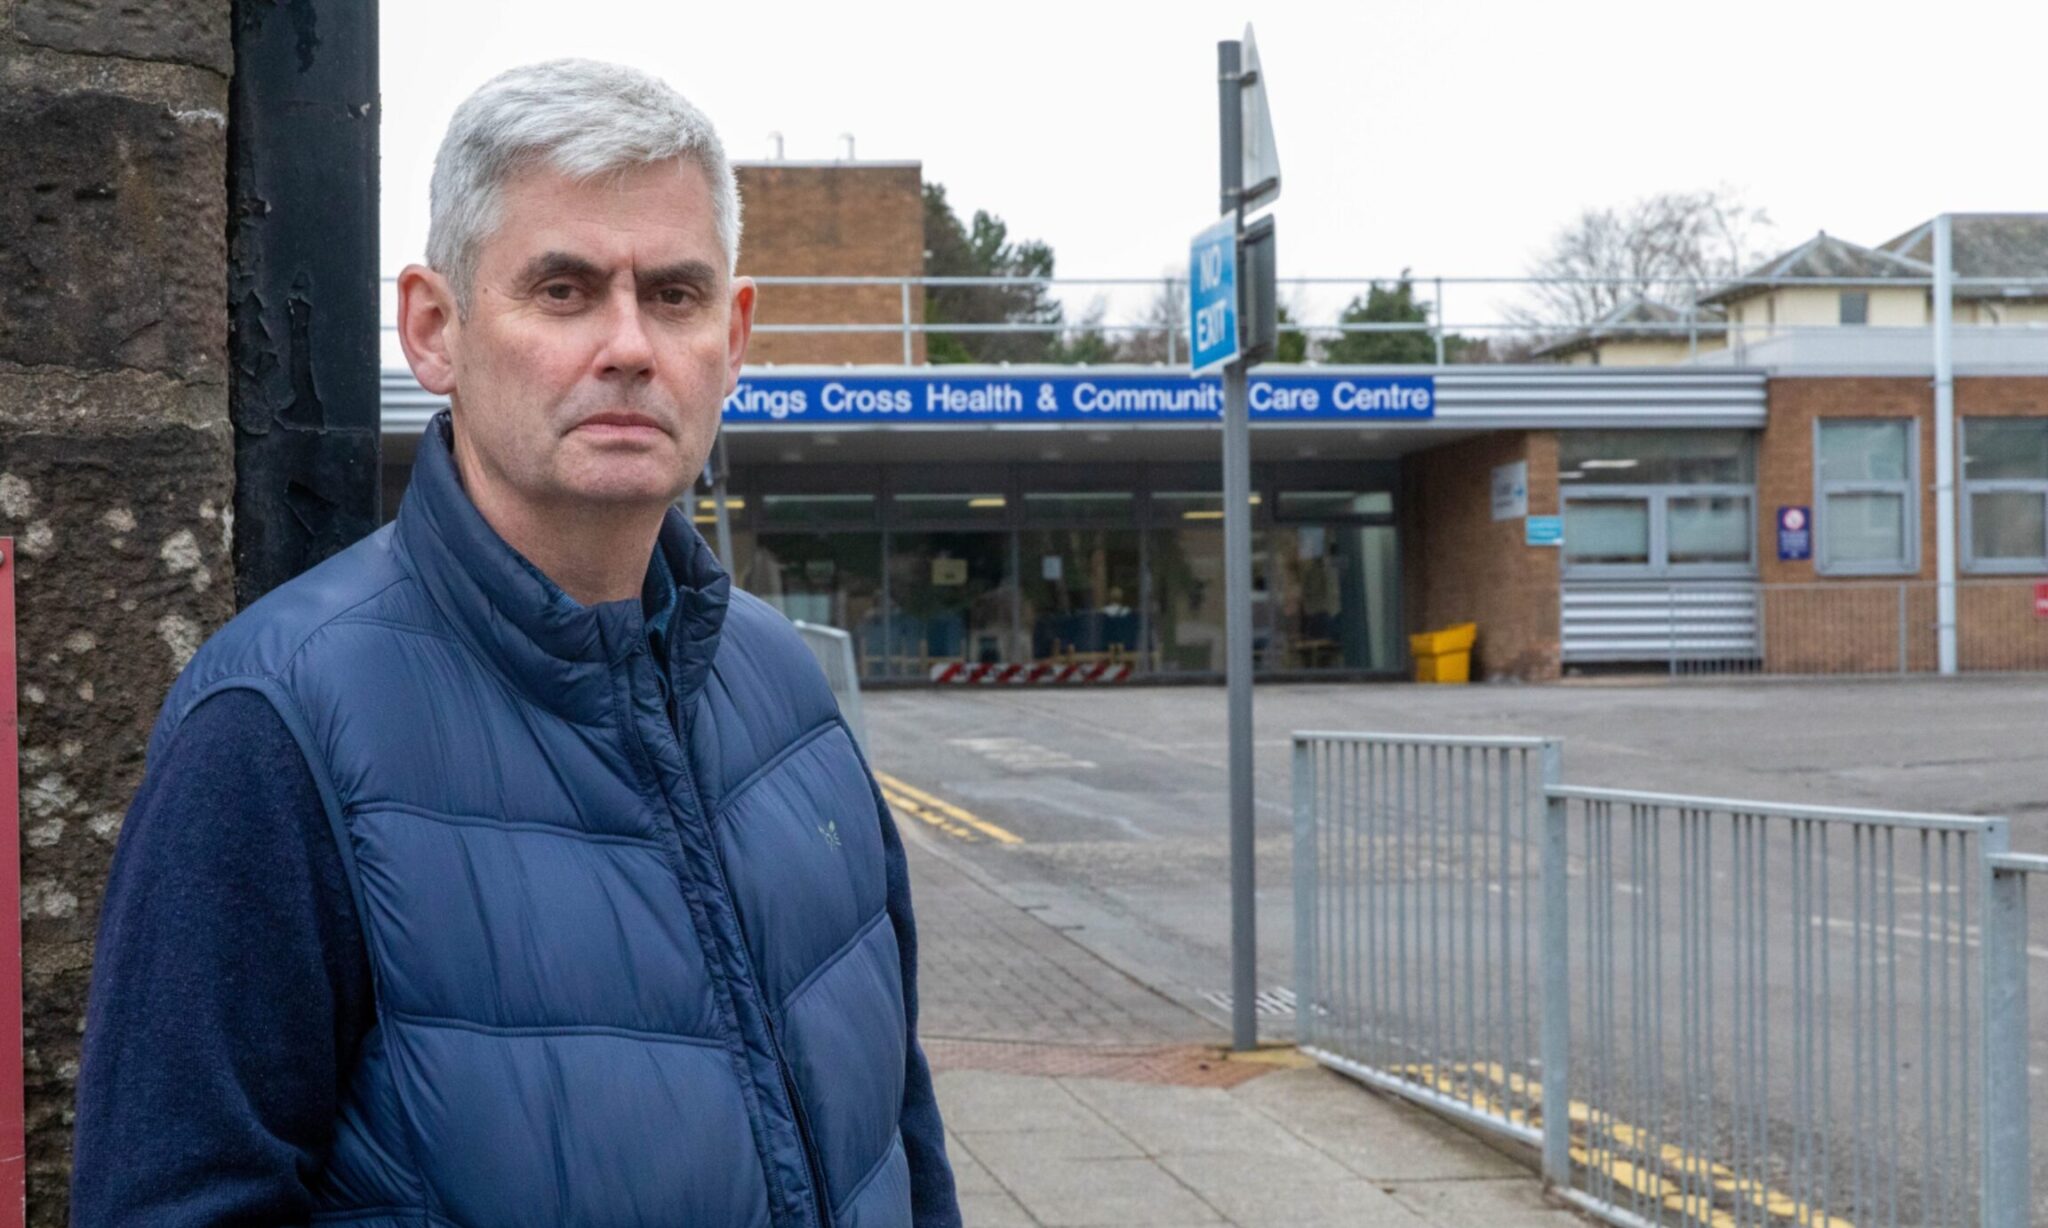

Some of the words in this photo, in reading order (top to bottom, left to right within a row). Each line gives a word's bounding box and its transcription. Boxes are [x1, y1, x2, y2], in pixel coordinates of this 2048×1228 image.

[1199, 245, 1222, 292] NO
[1196, 299, 1227, 352] EXIT
[723, 384, 807, 418] Kings
[821, 383, 912, 412] Cross
[927, 383, 1022, 412] Health
[1037, 383, 1058, 411] &
[1249, 382, 1320, 410] Care
[1332, 381, 1430, 410] Centre
